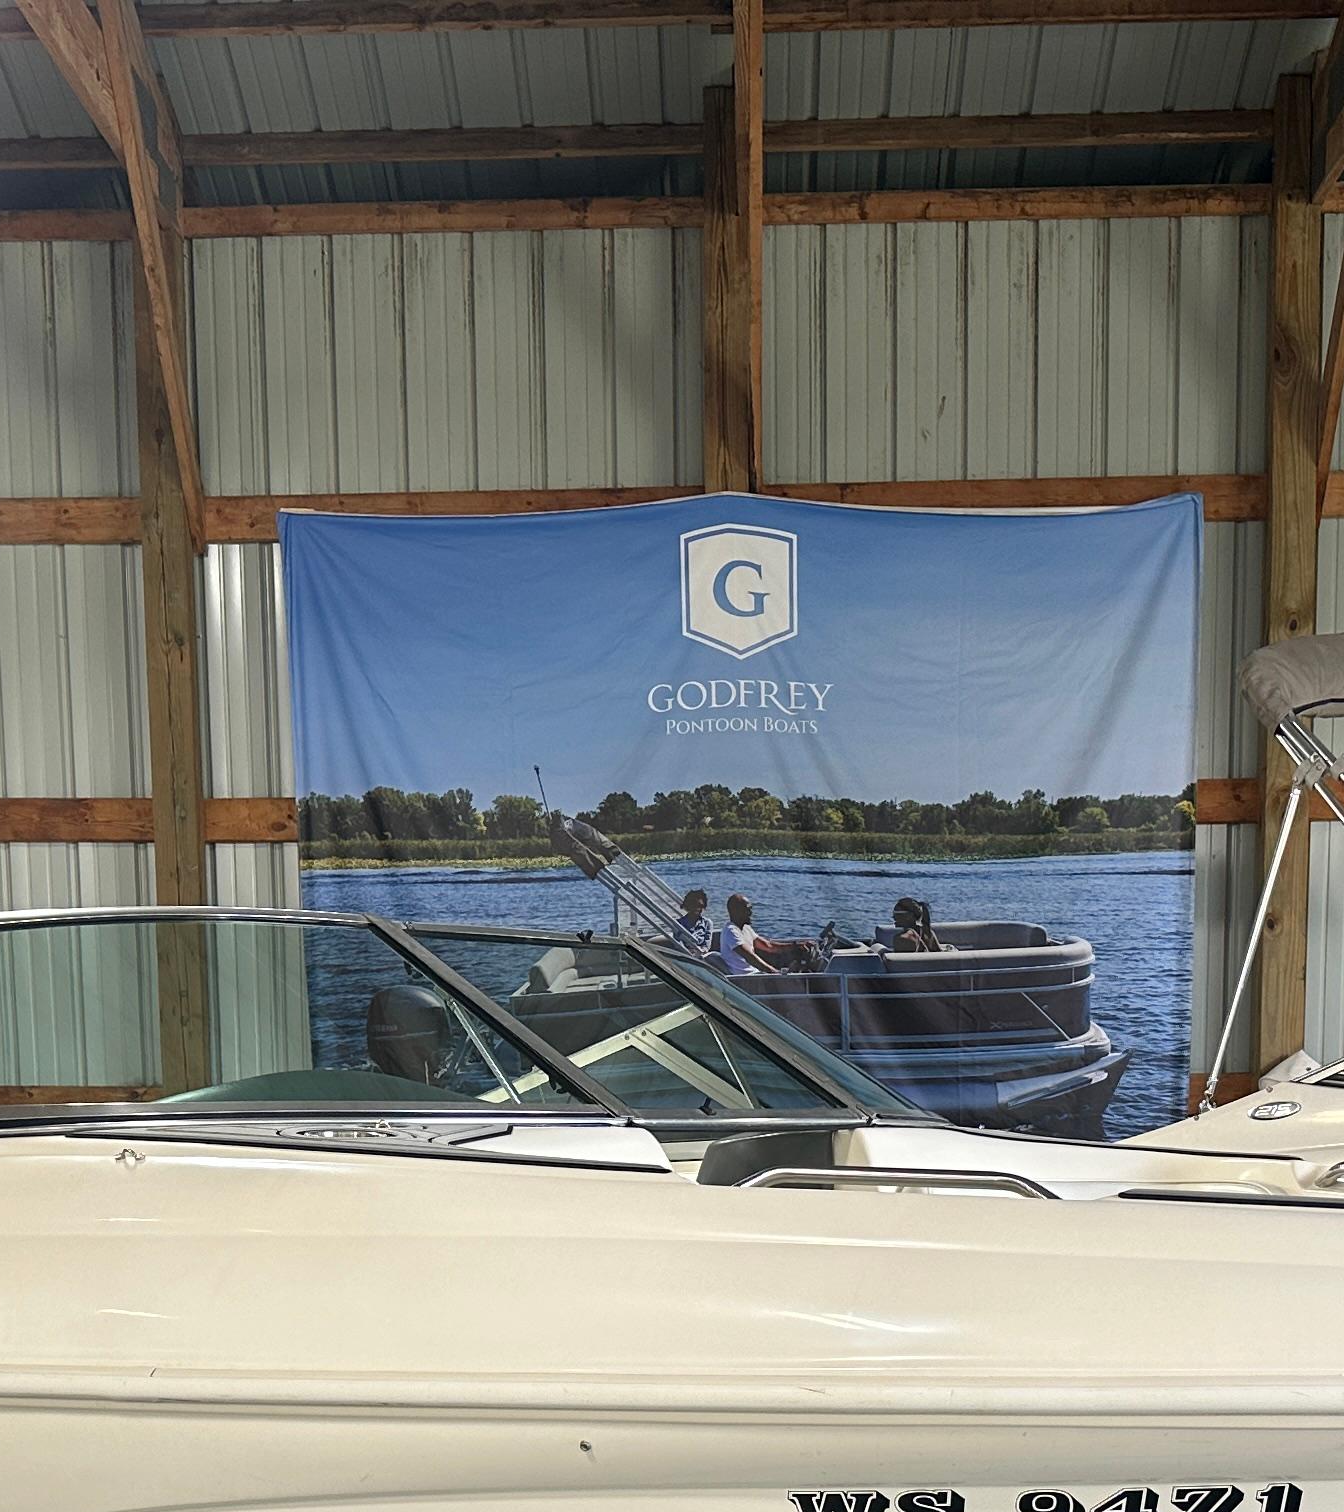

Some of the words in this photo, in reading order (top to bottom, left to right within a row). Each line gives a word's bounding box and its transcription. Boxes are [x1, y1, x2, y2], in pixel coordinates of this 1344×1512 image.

[712, 559, 770, 618] G
[647, 679, 834, 715] GODFREY
[666, 717, 758, 736] PONTOON
[763, 716, 818, 735] BOATS
